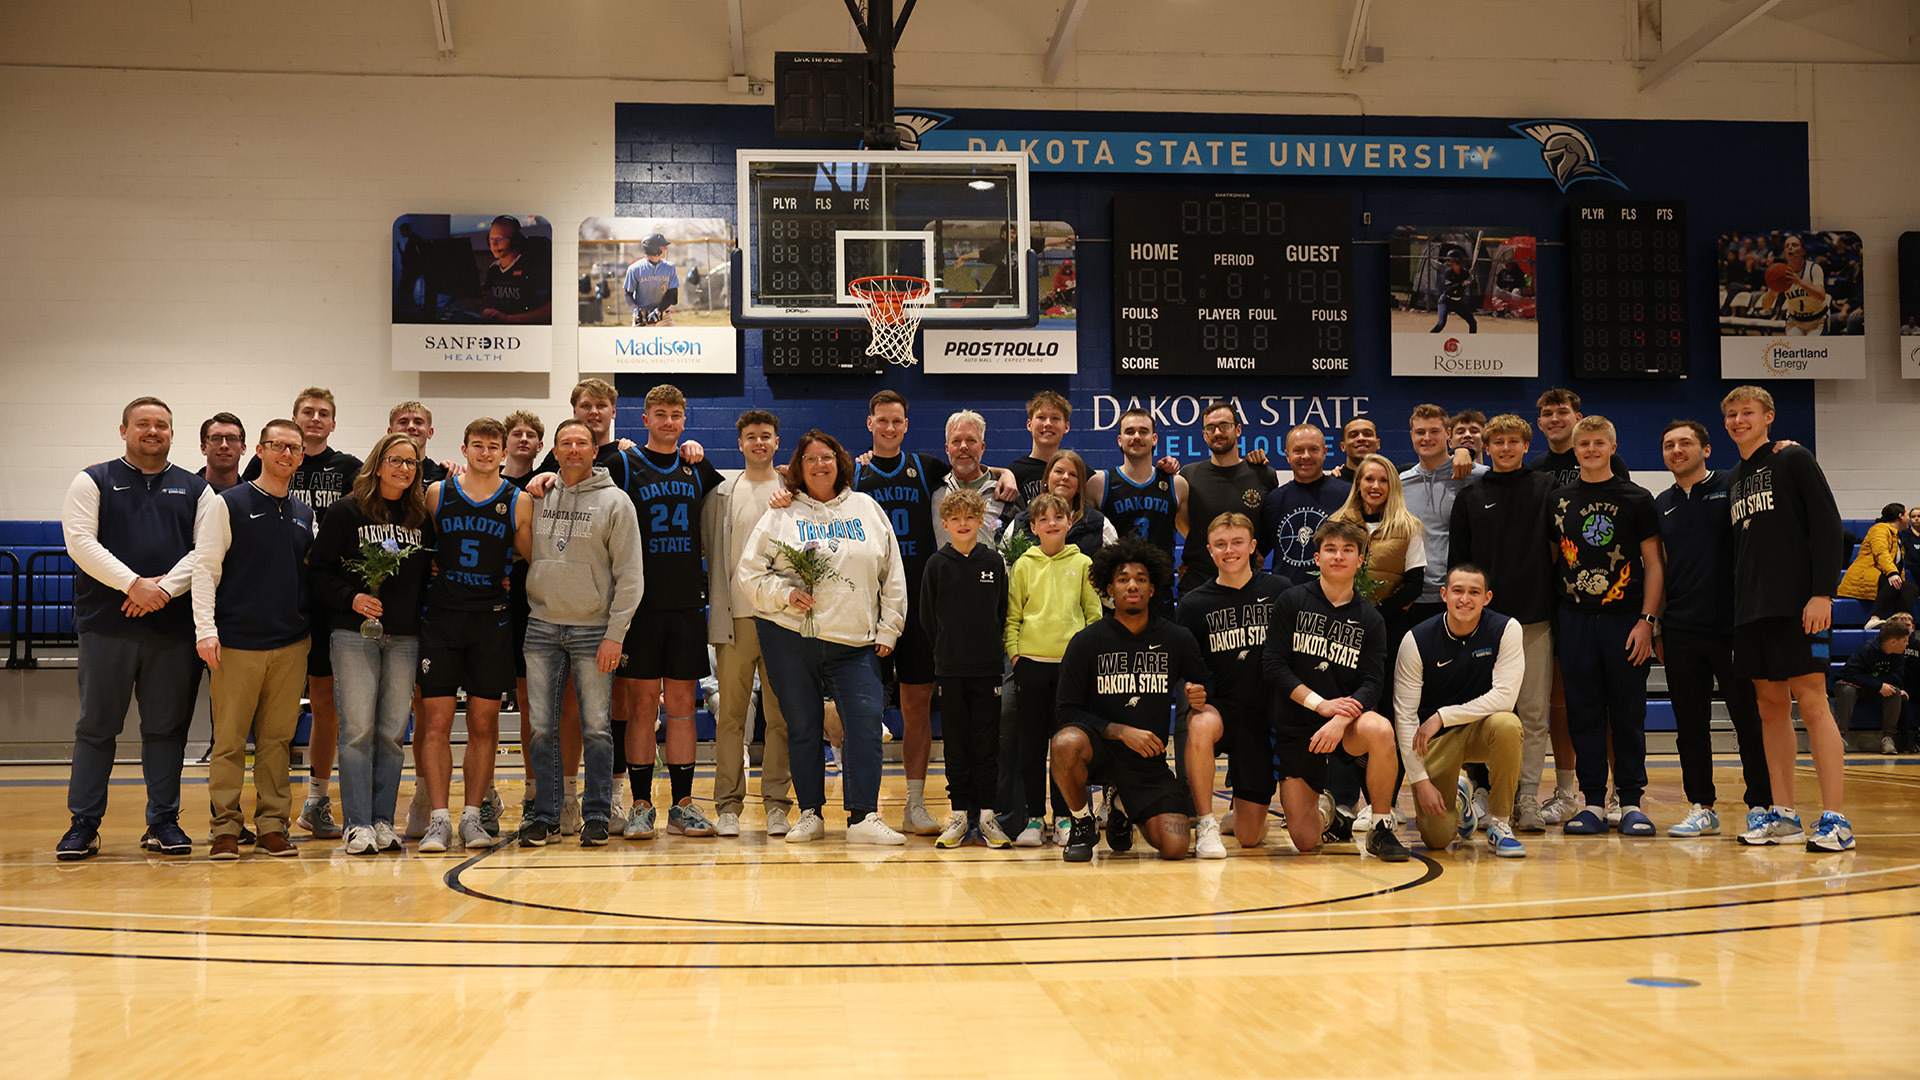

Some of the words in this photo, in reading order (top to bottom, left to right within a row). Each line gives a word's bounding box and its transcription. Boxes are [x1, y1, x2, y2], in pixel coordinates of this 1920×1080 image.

[1135, 140, 1248, 166] STATE
[1269, 142, 1495, 170] UNIVERSITY
[773, 197, 798, 210] PLYR
[815, 198, 832, 210] FLS
[853, 198, 870, 211] PTS
[1581, 208, 1605, 220] PLYR
[1621, 208, 1637, 220] FLS
[1656, 208, 1674, 221] PTS
[1130, 243, 1179, 261] HOME
[1213, 254, 1255, 266] PERIOD
[1286, 245, 1340, 262] GUEST
[1122, 307, 1159, 320] FOULS
[1198, 308, 1241, 320] PLAYER
[1248, 308, 1277, 320] FOUL
[1311, 309, 1348, 322] FOULS
[425, 336, 521, 350] SANFORD
[615, 336, 702, 356] Madison
[944, 342, 1059, 357] PROSTROLLO
[1773, 348, 1829, 359] Heartland
[1121, 357, 1160, 370] SCORE
[1216, 357, 1256, 370] MATCH
[1311, 358, 1349, 370] SCORE
[1773, 359, 1809, 371] Energy
[1260, 395, 1369, 428] STATE
[309, 471, 344, 491] ARE
[1743, 470, 1773, 498] ARE
[639, 481, 695, 501] DAKOTA
[866, 486, 920, 504] AKOTA
[1113, 496, 1169, 515] DAKOTA
[1747, 490, 1775, 515] STATE
[650, 503, 689, 533] 24
[441, 516, 506, 539] DAKOTA
[1133, 517, 1150, 541] 3
[459, 538, 480, 568] 5
[649, 536, 692, 553] STATE
[446, 570, 492, 586] STATE
[1205, 607, 1238, 633] WE
[1209, 627, 1246, 653] DAKOTA
[1247, 625, 1269, 646] STA
[1295, 610, 1328, 637] WE
[1326, 620, 1365, 650] ARE
[1292, 632, 1328, 658] DAKOTA
[1327, 641, 1361, 669] STATE
[1097, 652, 1128, 676] WE
[1132, 652, 1169, 675] ARE
[1097, 674, 1137, 695] DAKOTA
[1138, 674, 1169, 694] STATE
